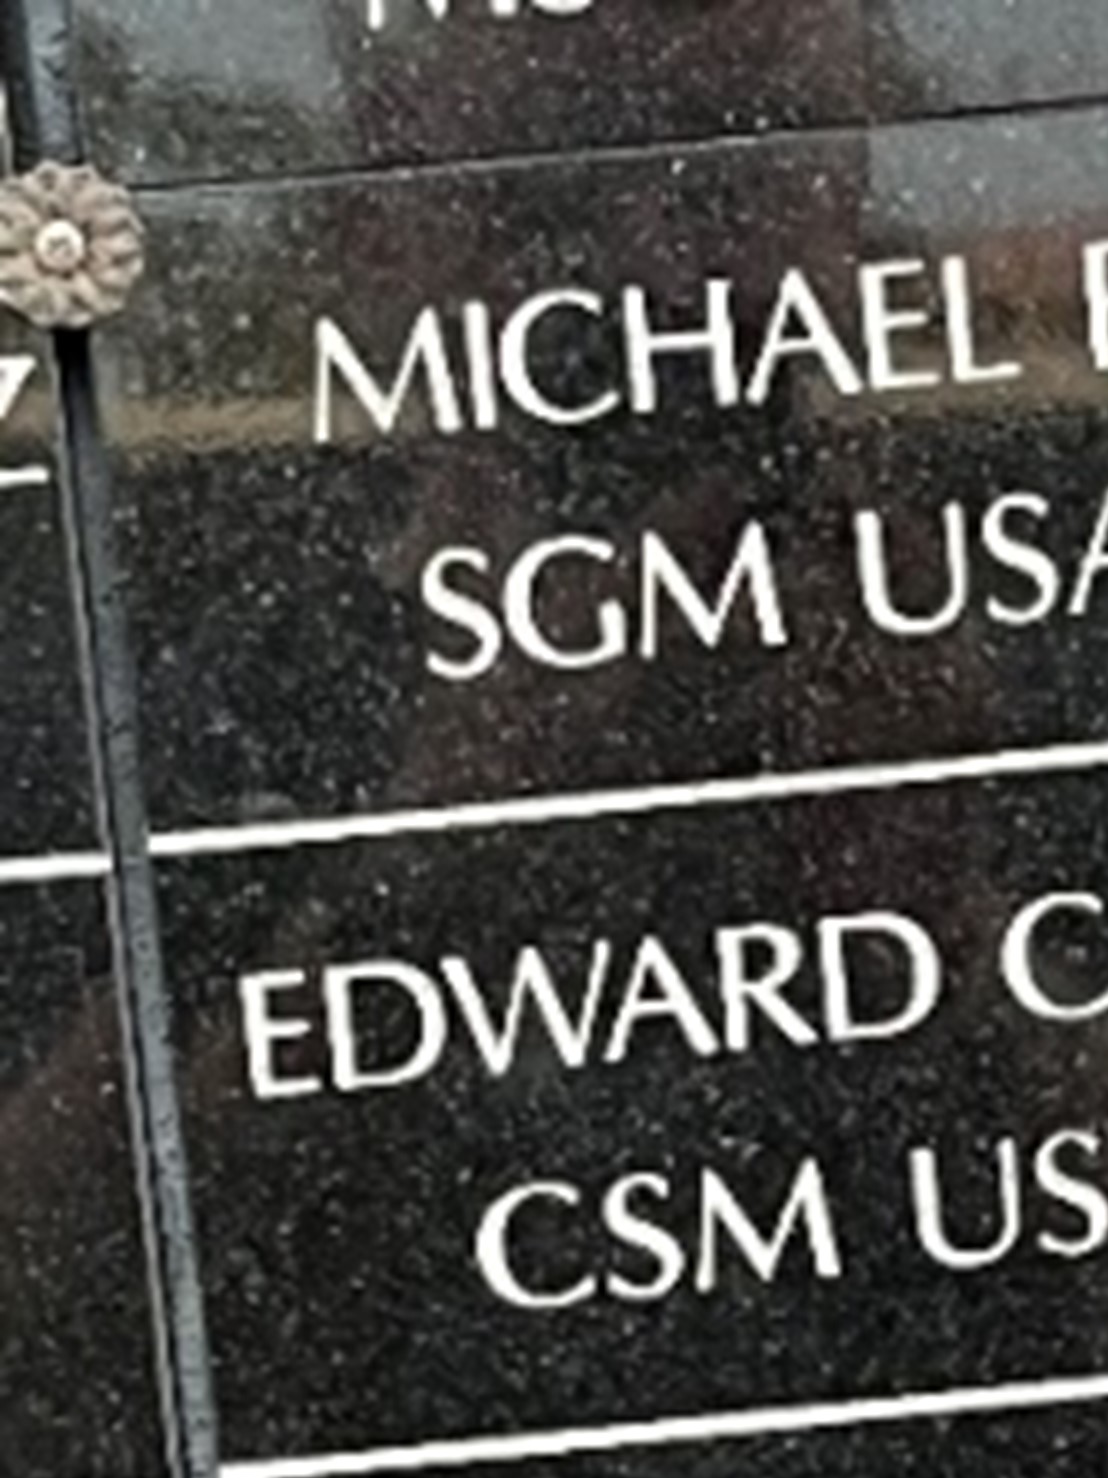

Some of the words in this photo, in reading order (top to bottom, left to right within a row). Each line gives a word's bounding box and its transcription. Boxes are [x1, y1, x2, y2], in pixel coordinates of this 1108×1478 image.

[313, 254, 1022, 444] MICHAEL
[420, 521, 788, 680] SGM
[239, 911, 940, 1099] EDWARD
[475, 1158, 842, 1309] CSM
